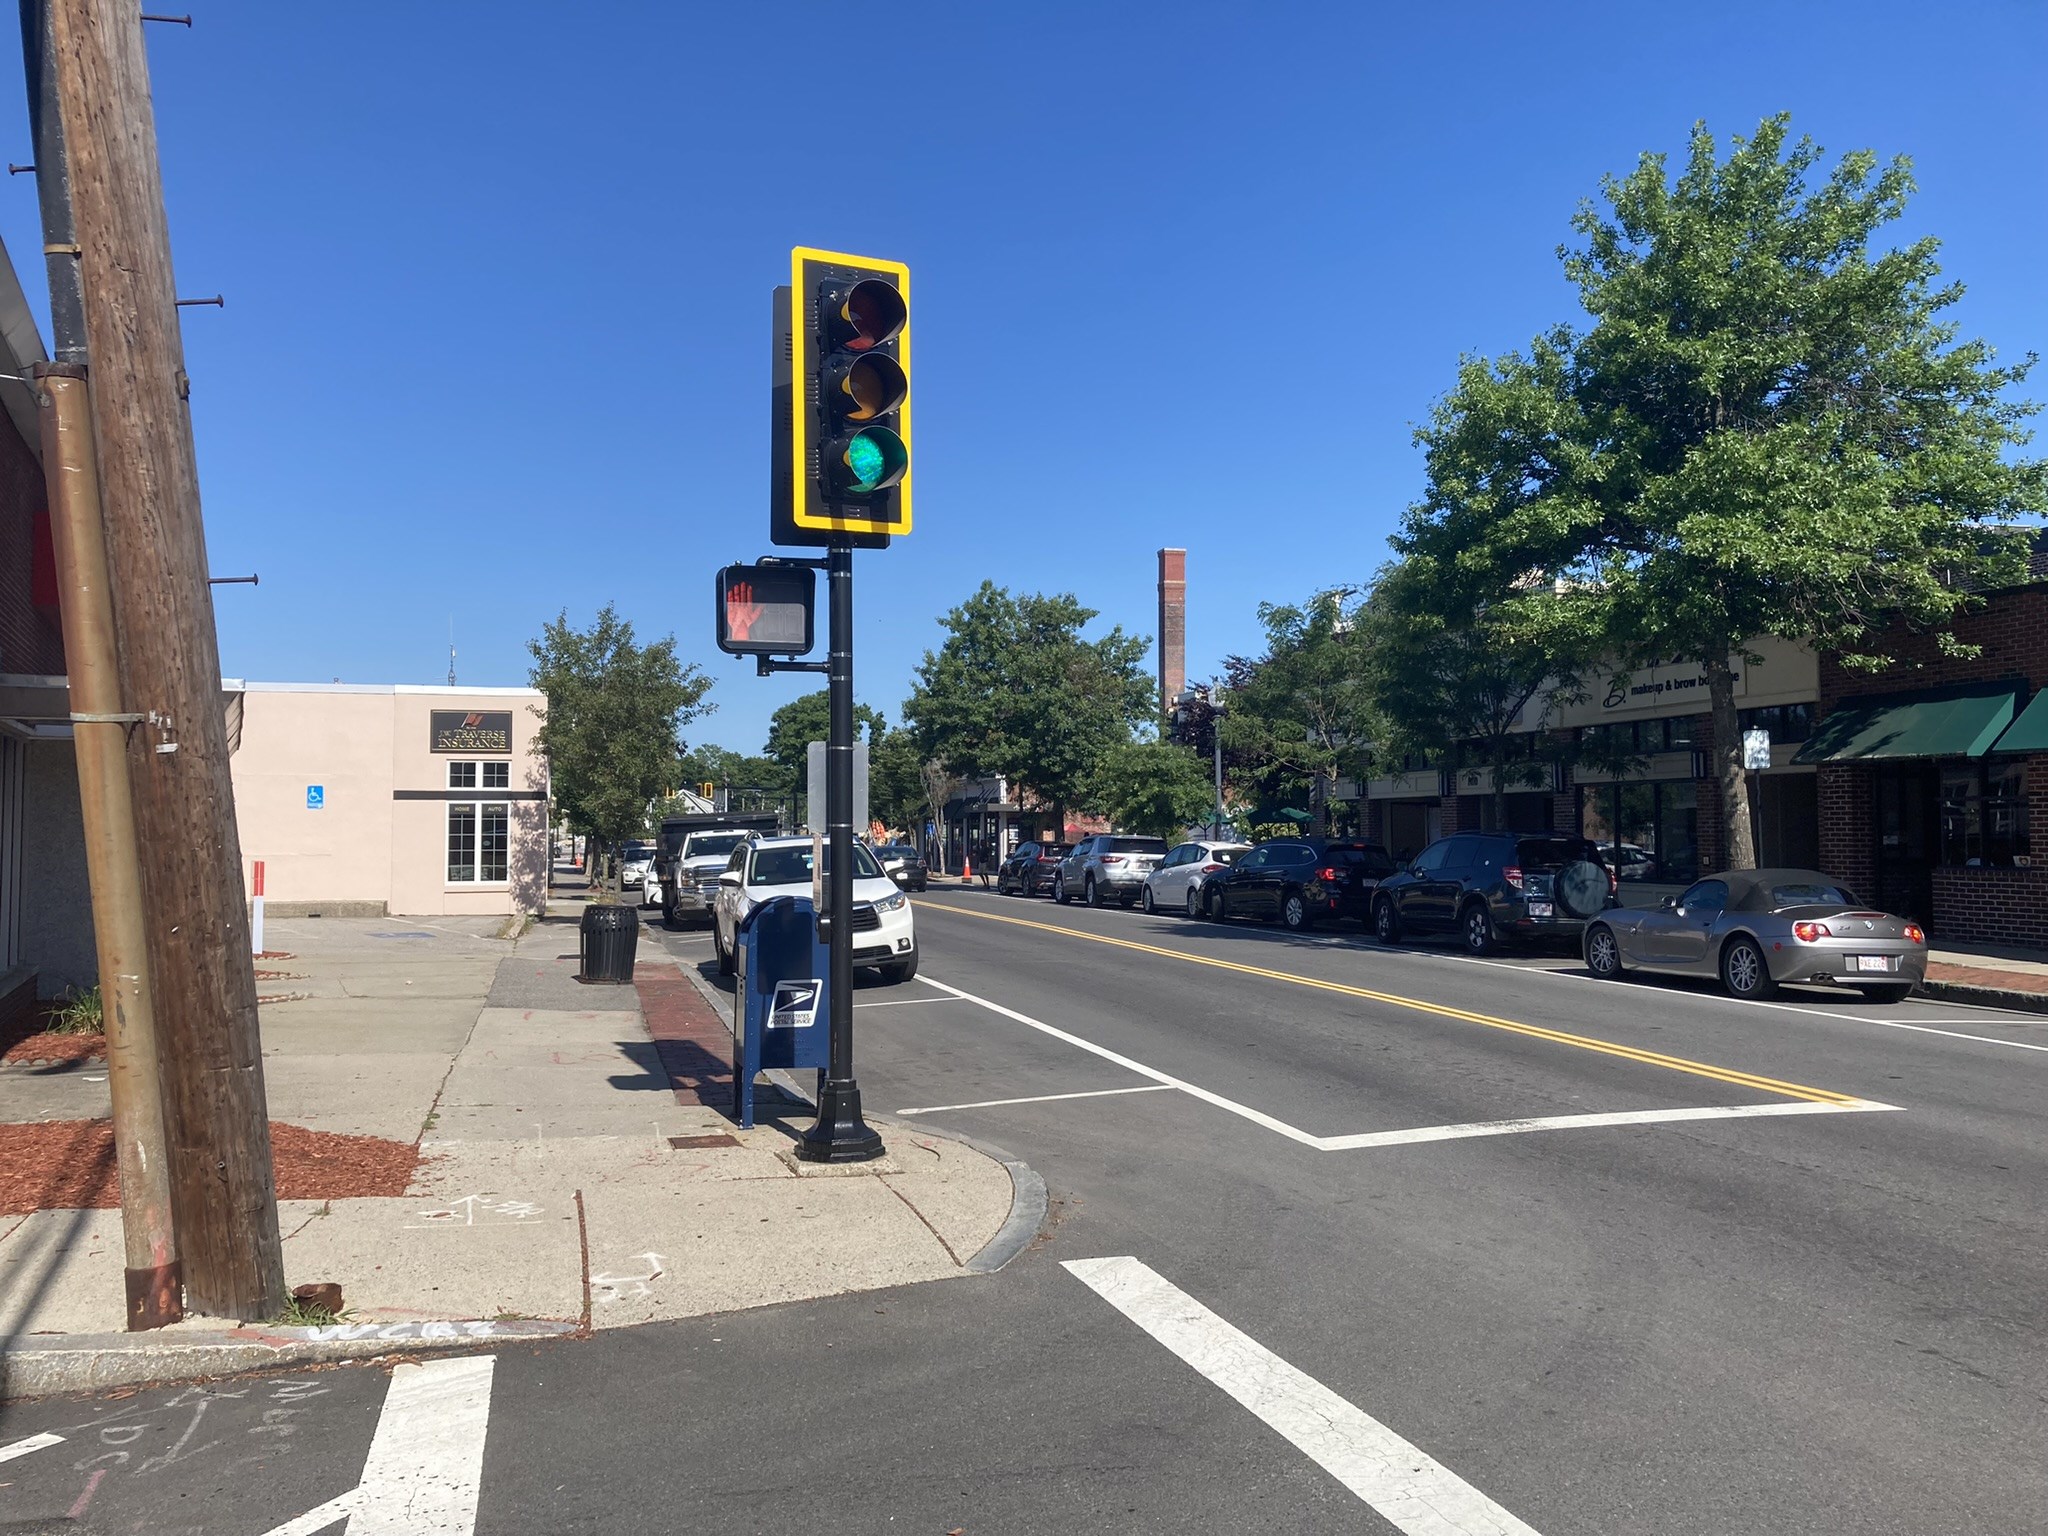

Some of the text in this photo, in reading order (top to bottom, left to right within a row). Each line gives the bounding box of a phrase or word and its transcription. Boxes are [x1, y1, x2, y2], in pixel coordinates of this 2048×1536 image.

[1631, 682, 1664, 696] makeup
[1665, 680, 1672, 691] &
[1674, 677, 1696, 690] brow
[453, 729, 506, 739] TRAVERSE
[438, 738, 506, 748] INSURANCE
